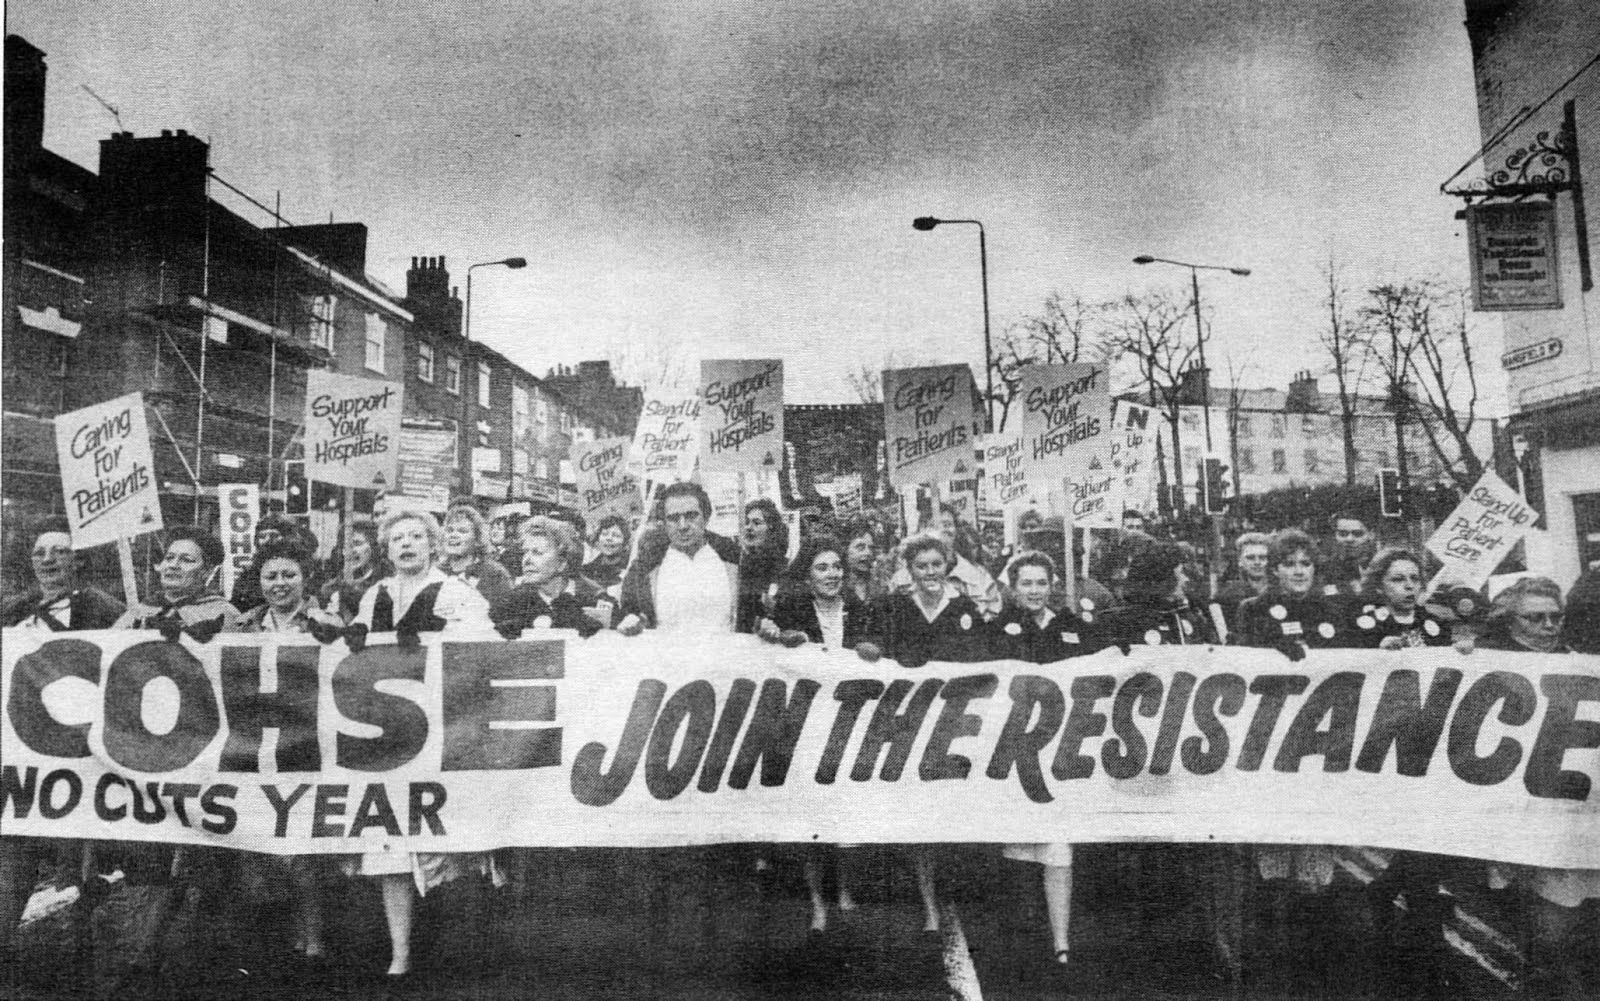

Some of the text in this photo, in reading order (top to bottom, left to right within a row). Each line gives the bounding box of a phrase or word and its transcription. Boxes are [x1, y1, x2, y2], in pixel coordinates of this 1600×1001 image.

[705, 363, 780, 405] Support
[894, 376, 956, 411] Caring
[1026, 366, 1103, 412] Support
[312, 386, 396, 418] Support
[646, 399, 686, 417] Stand
[719, 397, 757, 424] Your
[915, 402, 944, 429] For
[1041, 400, 1081, 430] Your
[71, 408, 131, 459] Caring
[328, 416, 370, 437] Your
[661, 415, 684, 434] For
[710, 411, 774, 454] Hospitals
[1032, 415, 1100, 460] Hospitals
[315, 432, 388, 466] Hospitals
[642, 433, 695, 451] Patient
[891, 420, 967, 462] Patients
[987, 437, 1020, 461] Stand
[94, 445, 123, 478] For
[580, 444, 622, 472] Caring
[645, 450, 678, 468] Care
[1005, 455, 1023, 470] For
[596, 464, 617, 484] For
[71, 461, 149, 519] Patients
[582, 475, 636, 506] Patients
[1000, 483, 1028, 501] Care
[1073, 497, 1104, 516] Care
[1470, 486, 1530, 527] Stand Up
[1476, 509, 1504, 530] For
[1446, 536, 1482, 561] Care
[1450, 516, 1505, 550] Patient
[8, 637, 566, 773] COHSE
[570, 666, 1600, 807] JOIN THE RESISTANCE
[0, 765, 449, 839] NO CUTS YEAR
